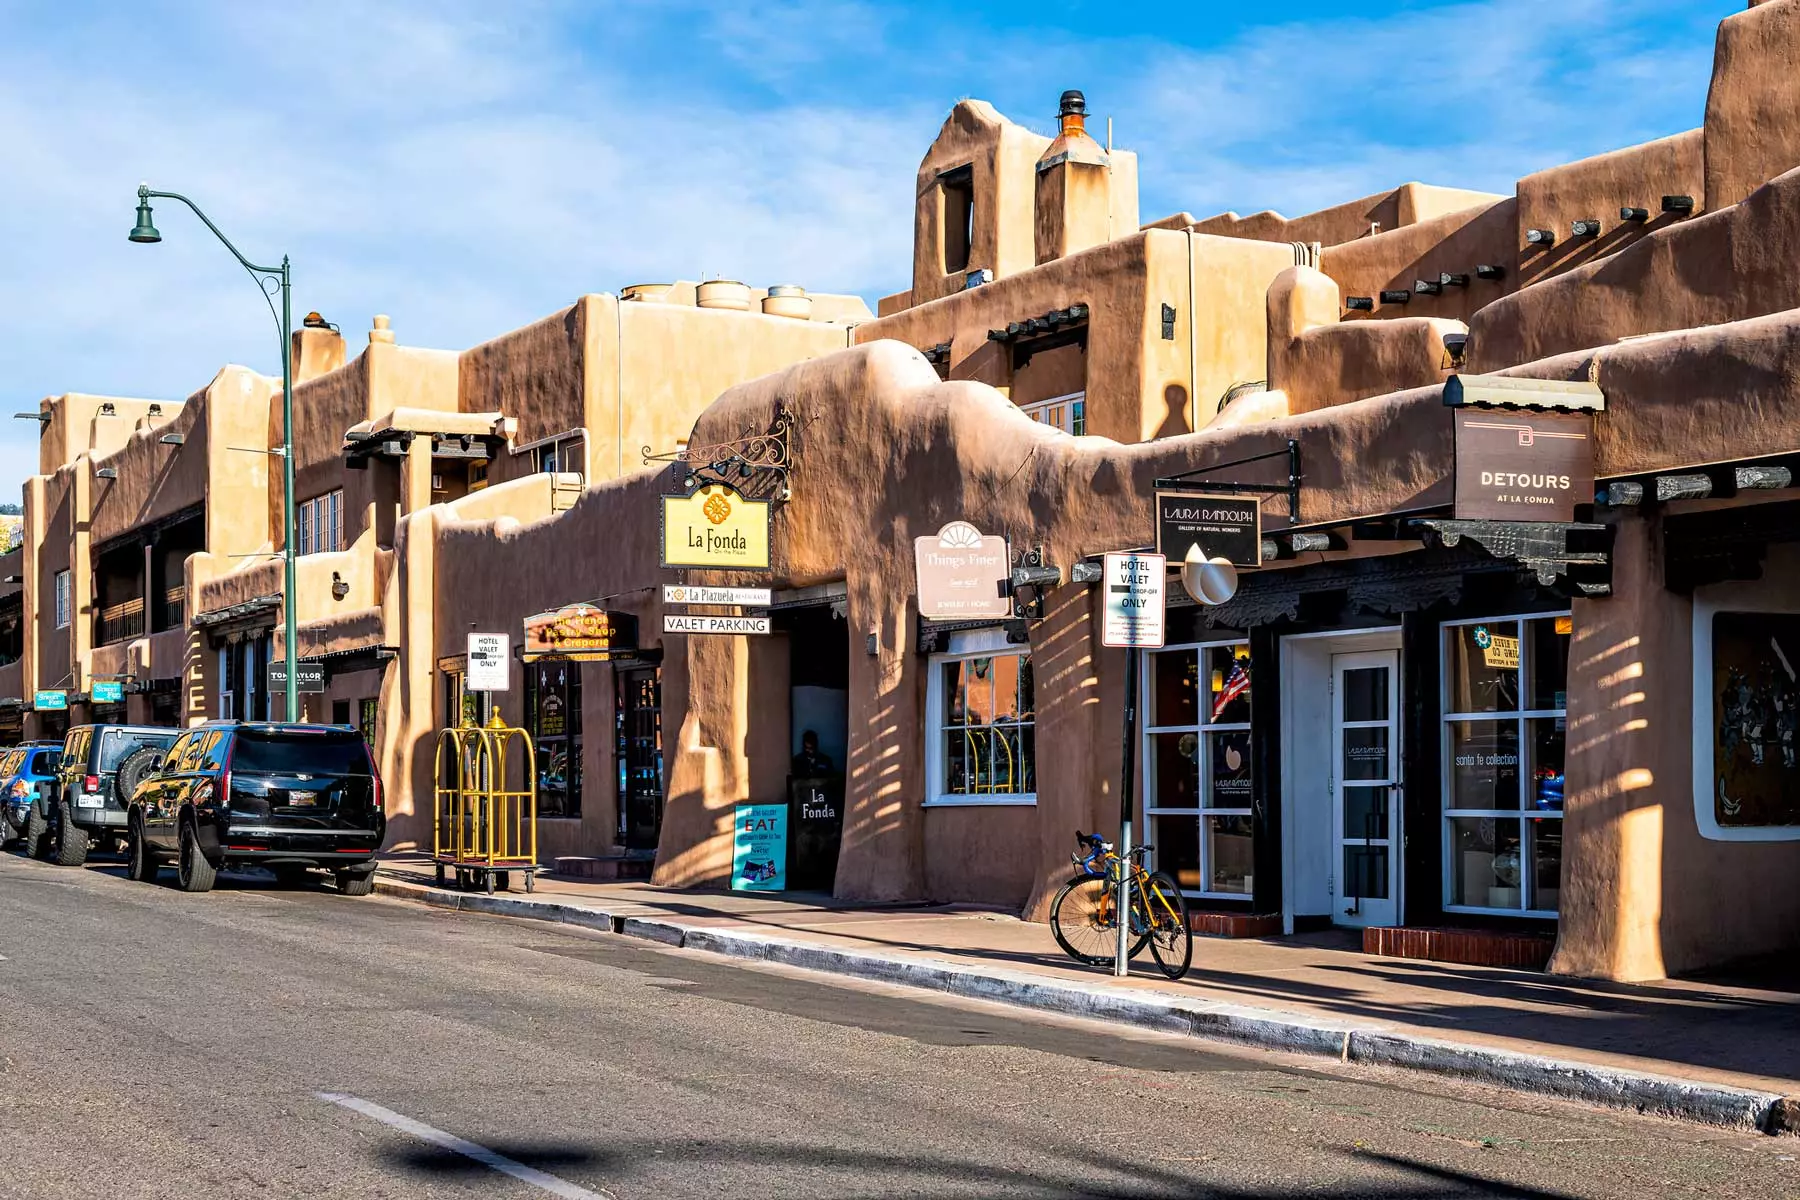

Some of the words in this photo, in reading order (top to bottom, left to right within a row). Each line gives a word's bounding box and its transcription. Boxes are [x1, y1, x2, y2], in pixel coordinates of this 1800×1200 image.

[1481, 471, 1570, 489] DETOURS
[1511, 495, 1521, 503] LA
[1524, 496, 1555, 504] FONDA
[1164, 507, 1199, 520] LAURA
[1202, 509, 1253, 522] RANDOLPH
[688, 526, 703, 548] La
[707, 528, 746, 552] Fonda
[925, 552, 966, 568] Things
[969, 553, 999, 566] Finer
[1120, 560, 1150, 571] HOTEL
[1120, 574, 1149, 584] VALET
[689, 589, 699, 601] La
[701, 588, 734, 602] Plazuela
[1121, 598, 1147, 608] ONLY
[575, 615, 609, 625] French
[667, 618, 706, 630] VALET
[710, 619, 765, 631] PARKING
[545, 627, 581, 637] Pastry
[588, 627, 616, 637] Shop
[478, 637, 499, 645] HOTEL
[554, 639, 561, 647] &
[296, 672, 321, 680] AYLOR
[1456, 755, 1474, 766] santa
[1477, 753, 1484, 766] fe
[1486, 753, 1517, 766] collection
[811, 788, 825, 803] La
[802, 803, 835, 819] Fonda
[745, 818, 777, 832] EAT
